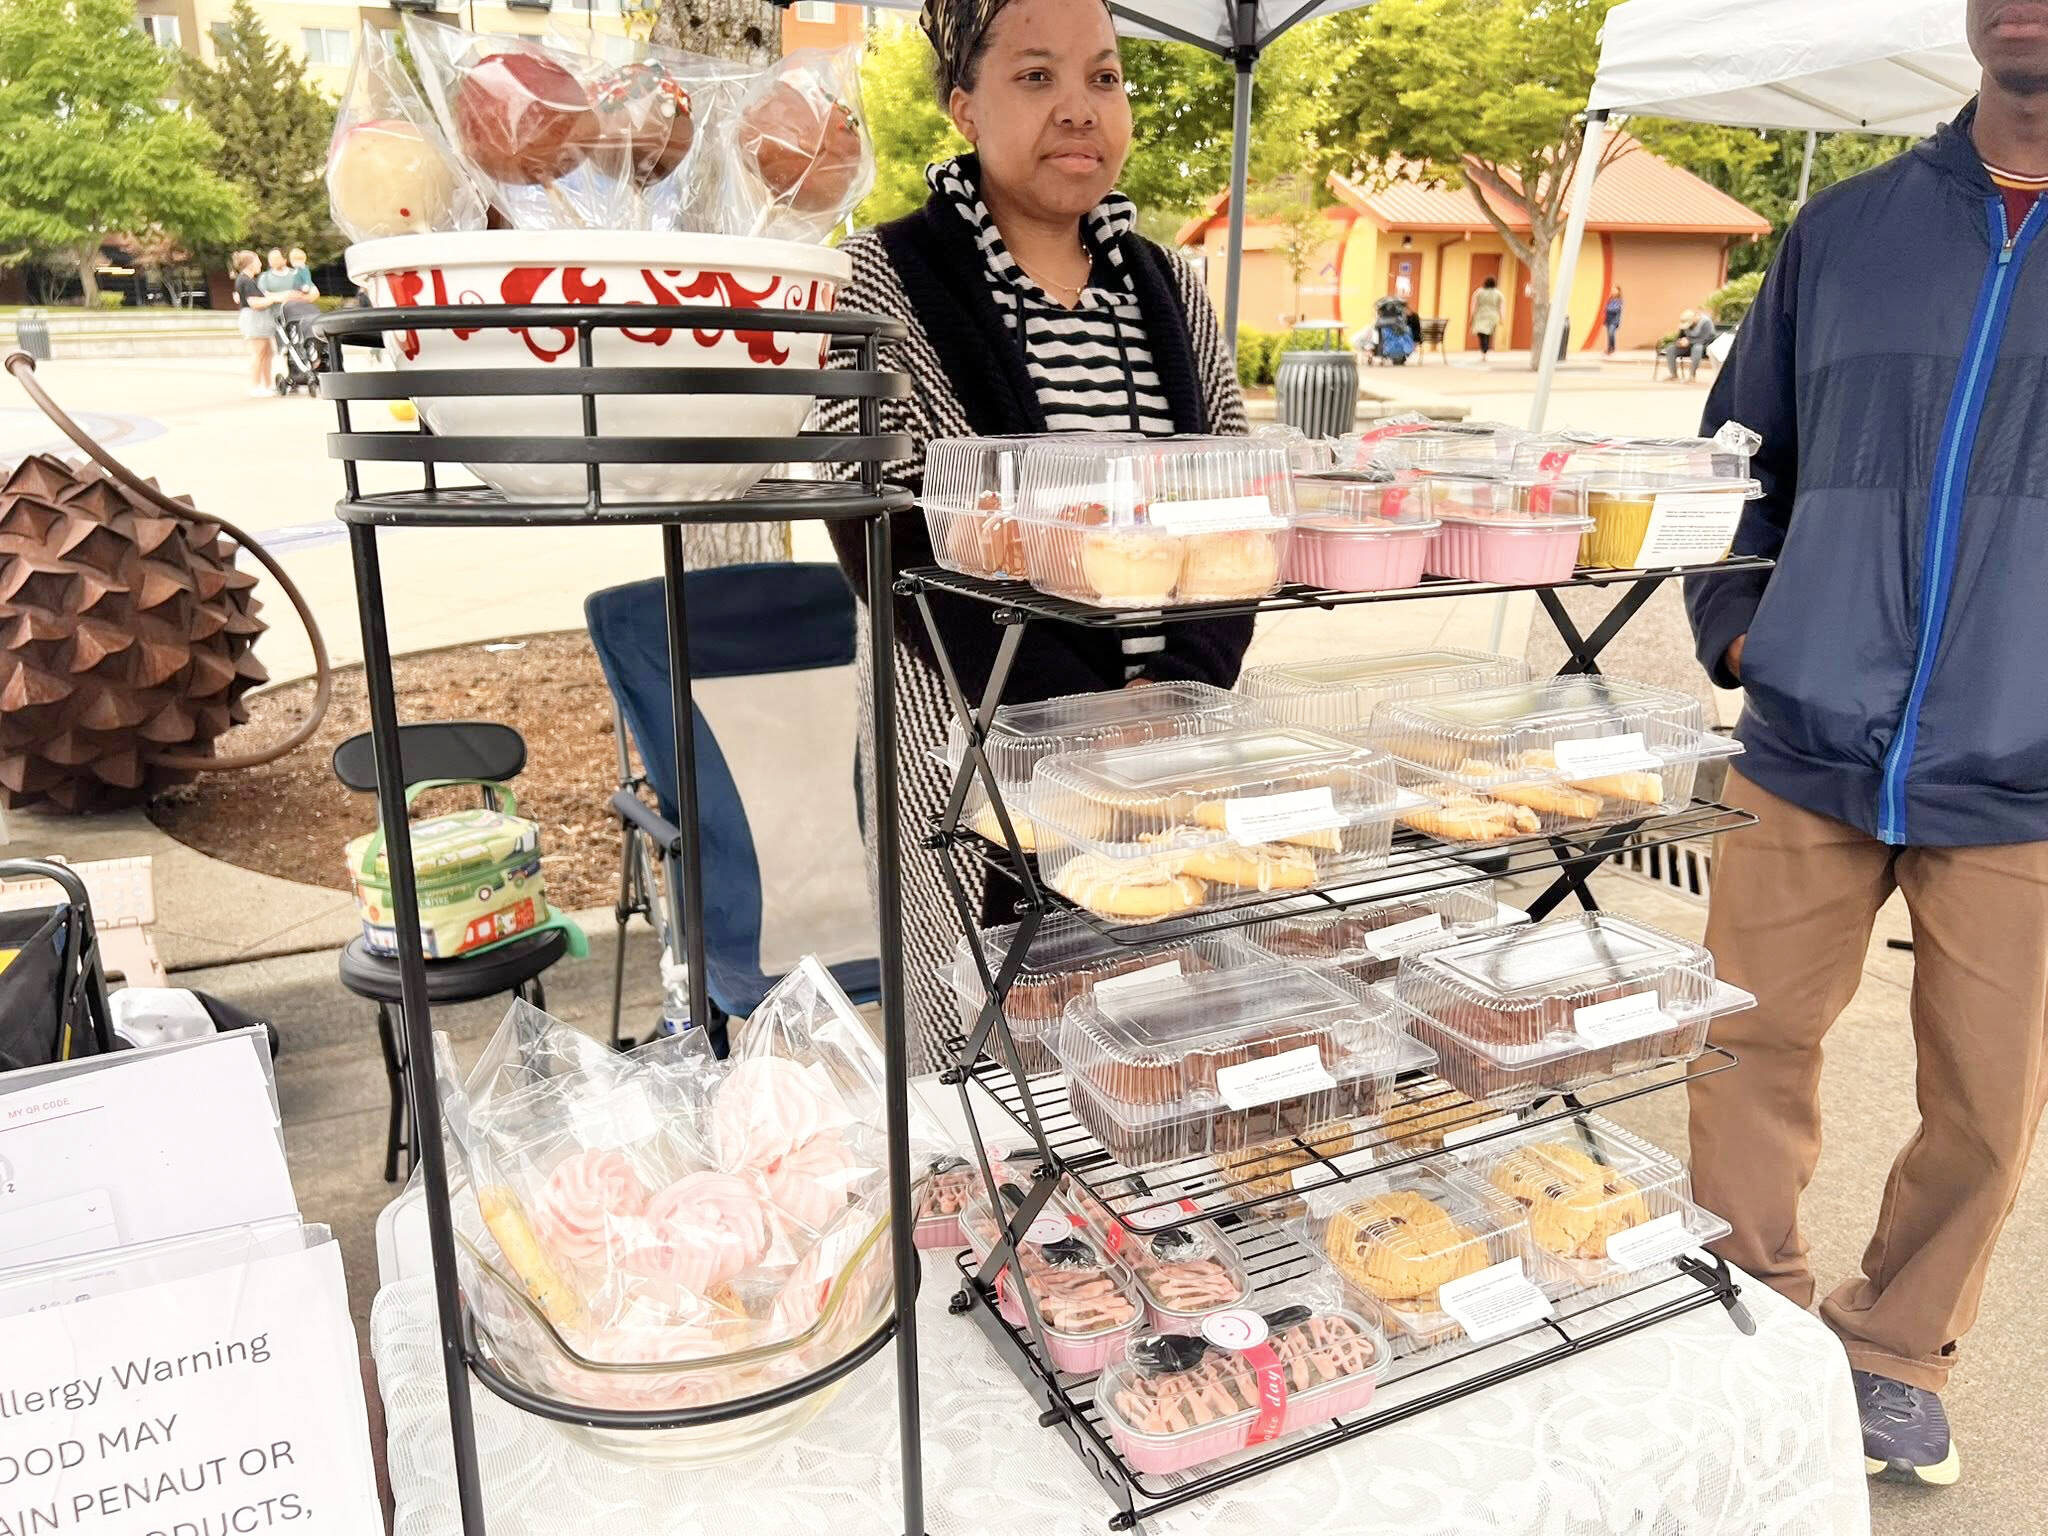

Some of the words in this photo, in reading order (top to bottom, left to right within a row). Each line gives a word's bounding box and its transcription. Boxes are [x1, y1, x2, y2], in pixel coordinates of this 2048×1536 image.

[8, 1109, 23, 1119] MY
[26, 1104, 40, 1114] QR
[43, 1098, 70, 1110] CODE
[112, 1333, 271, 1390] Warning
[1264, 1370, 1283, 1407] day
[98, 1413, 178, 1459] MAY
[73, 1457, 227, 1522] PENAUT
[239, 1440, 295, 1476] OR
[146, 1493, 312, 1536] UCTS,
